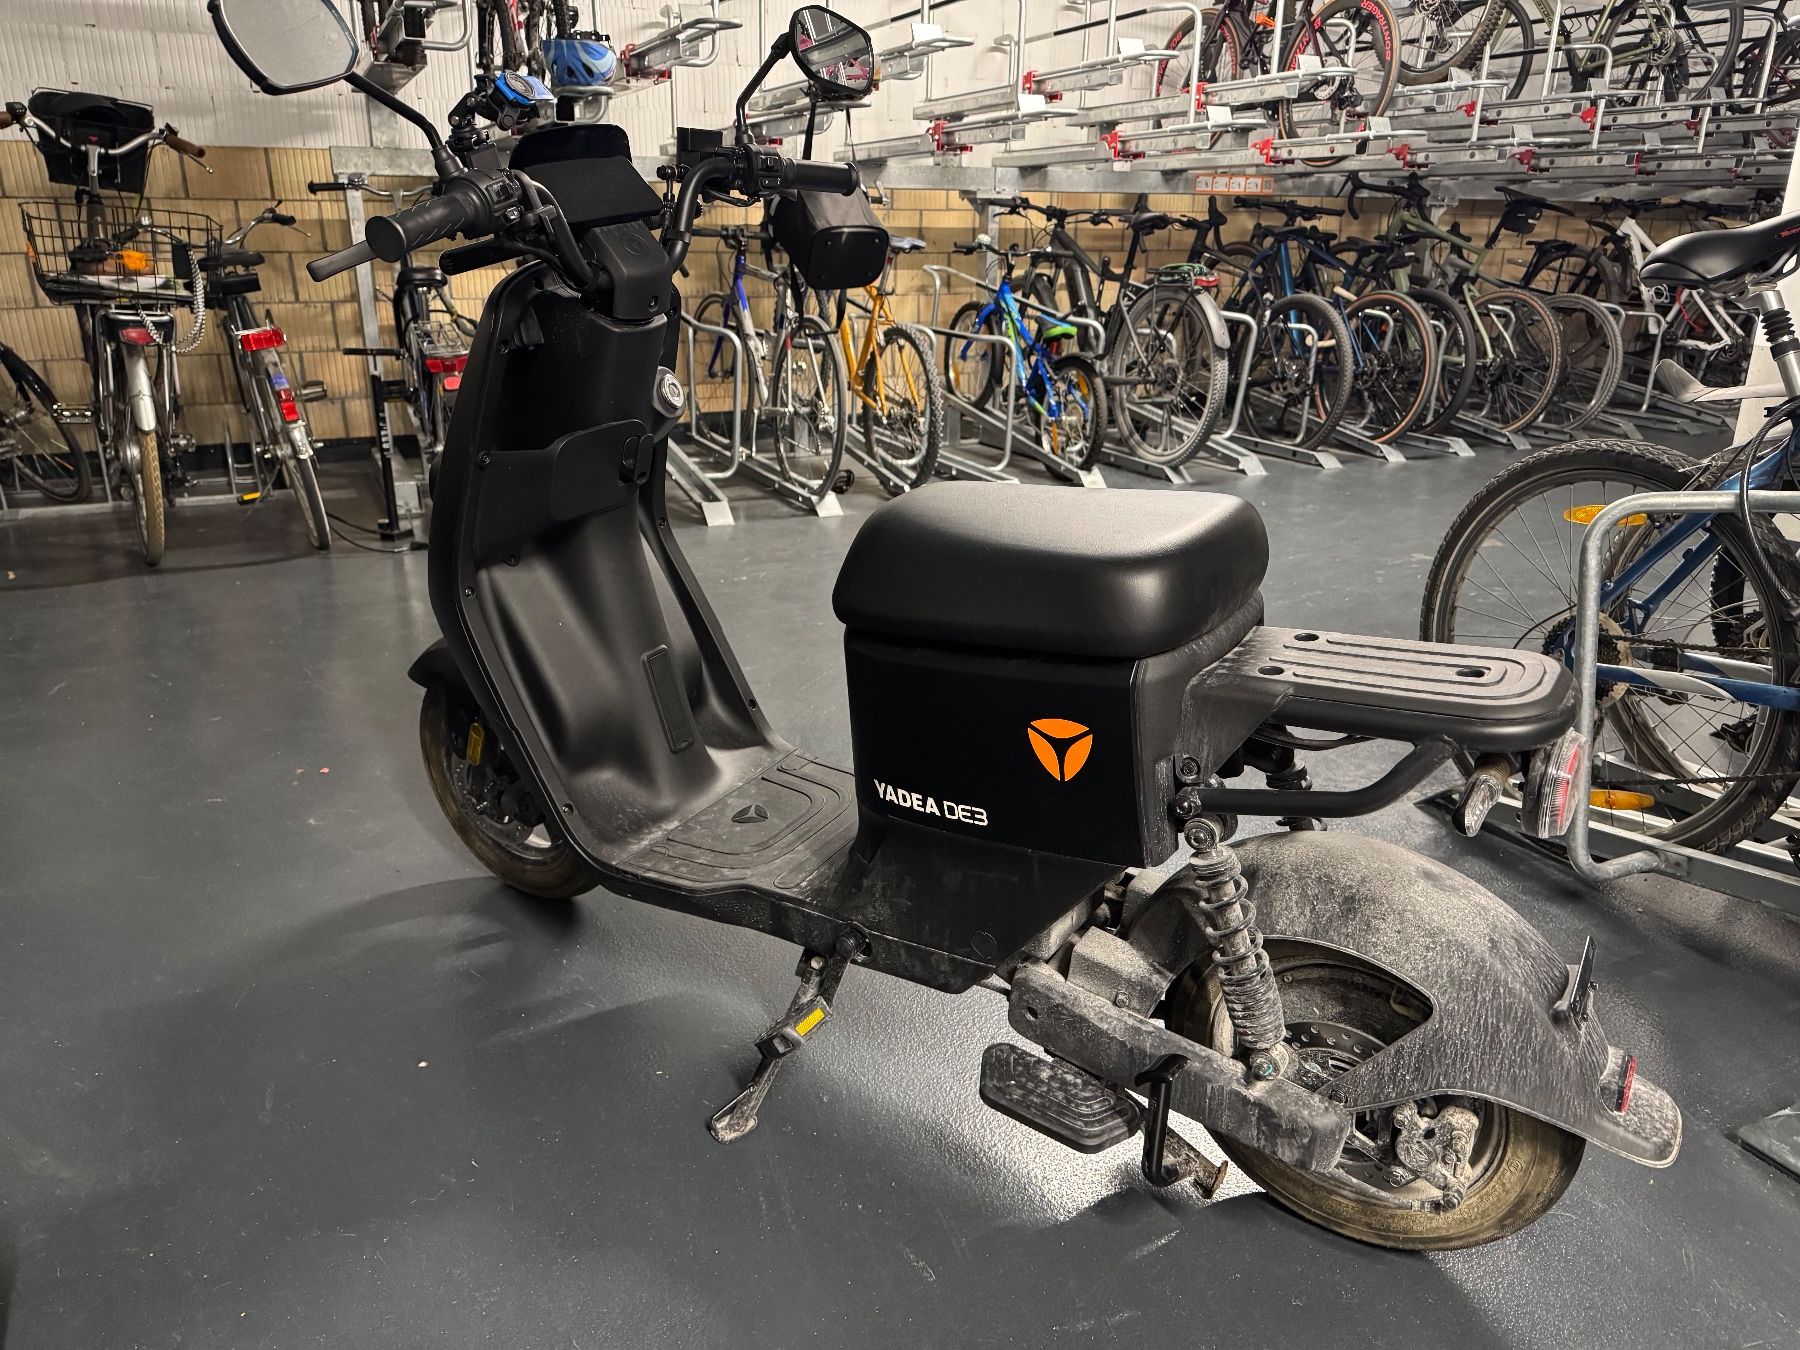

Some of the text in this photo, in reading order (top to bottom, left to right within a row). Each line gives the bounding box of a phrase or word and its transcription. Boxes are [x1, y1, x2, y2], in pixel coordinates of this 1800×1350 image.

[1360, 0, 1391, 61] BONTRAGER
[874, 779, 989, 827] YADEA DE3
